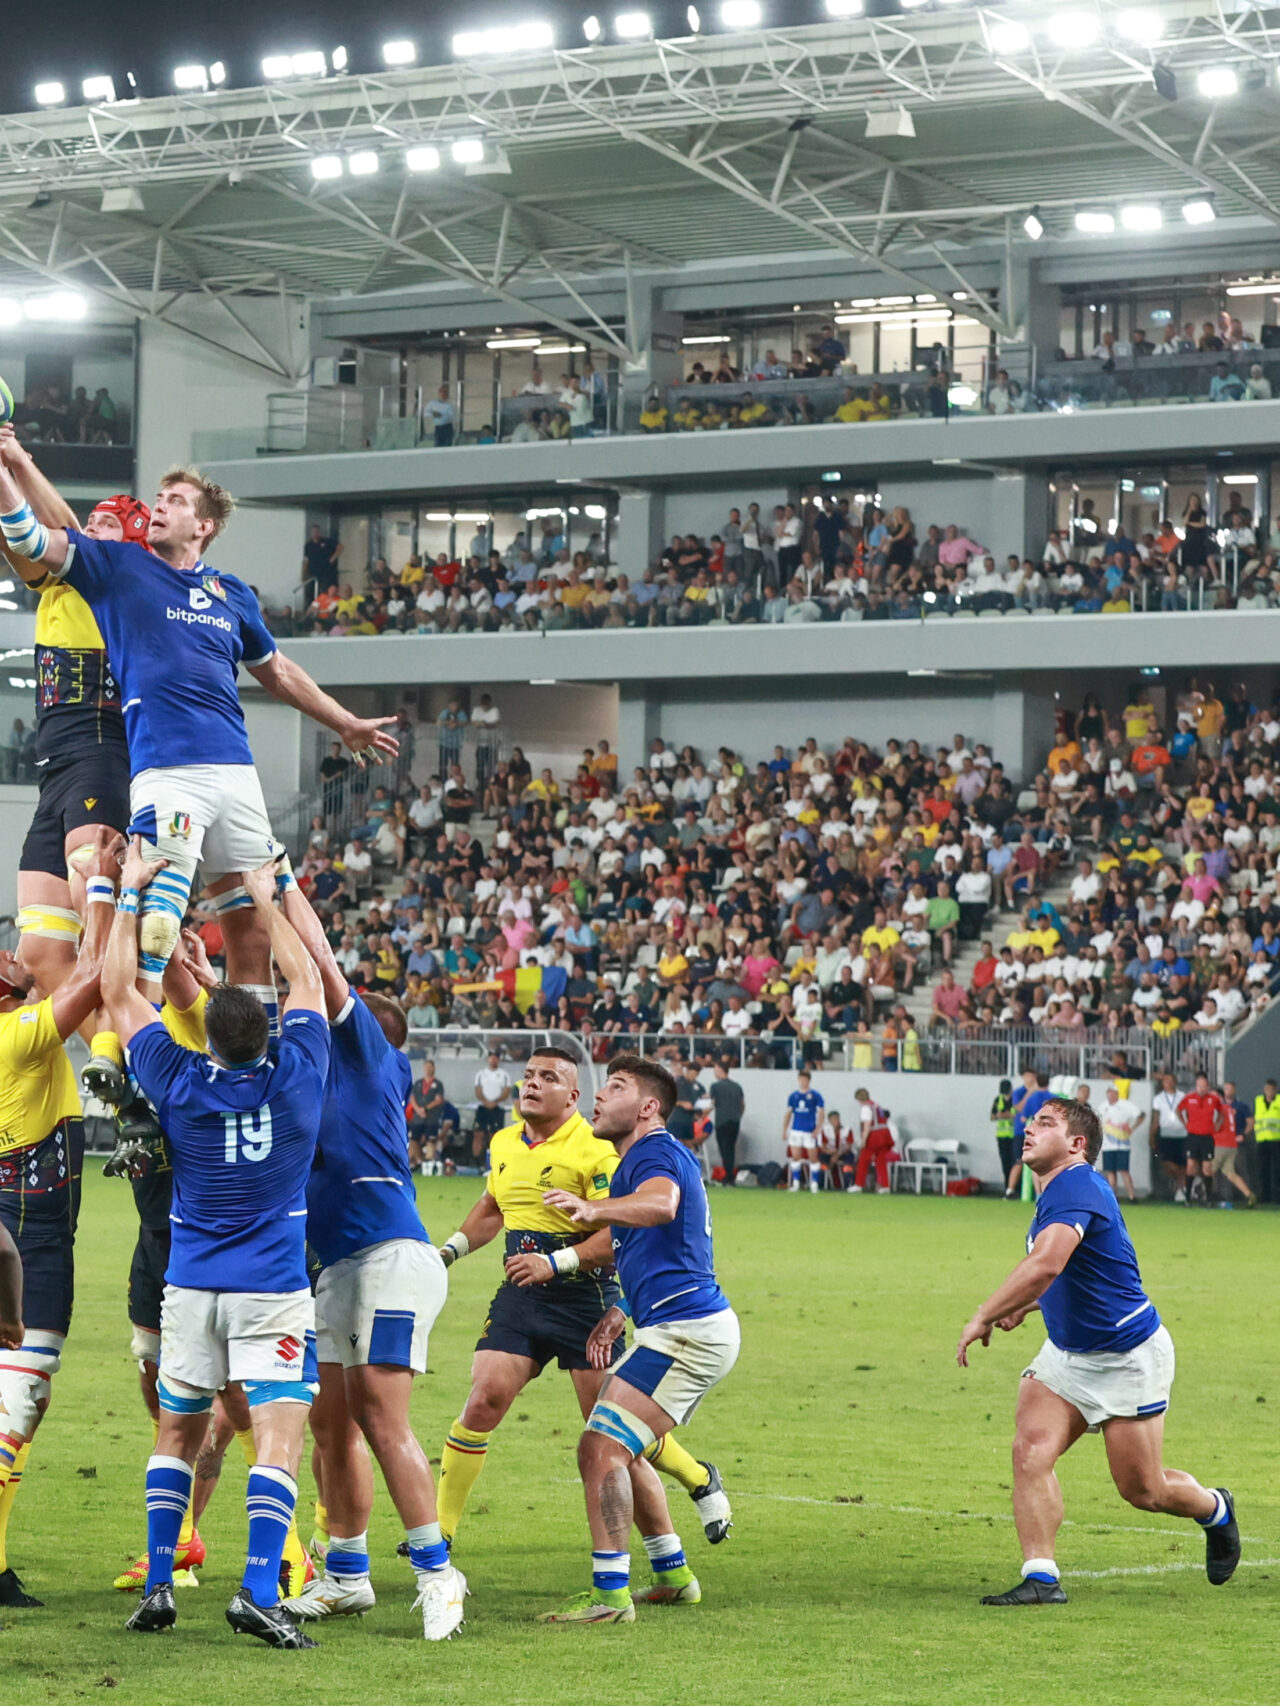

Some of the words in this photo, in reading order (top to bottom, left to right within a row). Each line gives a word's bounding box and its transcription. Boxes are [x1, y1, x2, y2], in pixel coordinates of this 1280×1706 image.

[166, 607, 231, 632] bitpanda
[220, 1103, 272, 1163] 19
[156, 1546, 176, 1555] ITALI
[246, 1556, 269, 1567] TALIA
